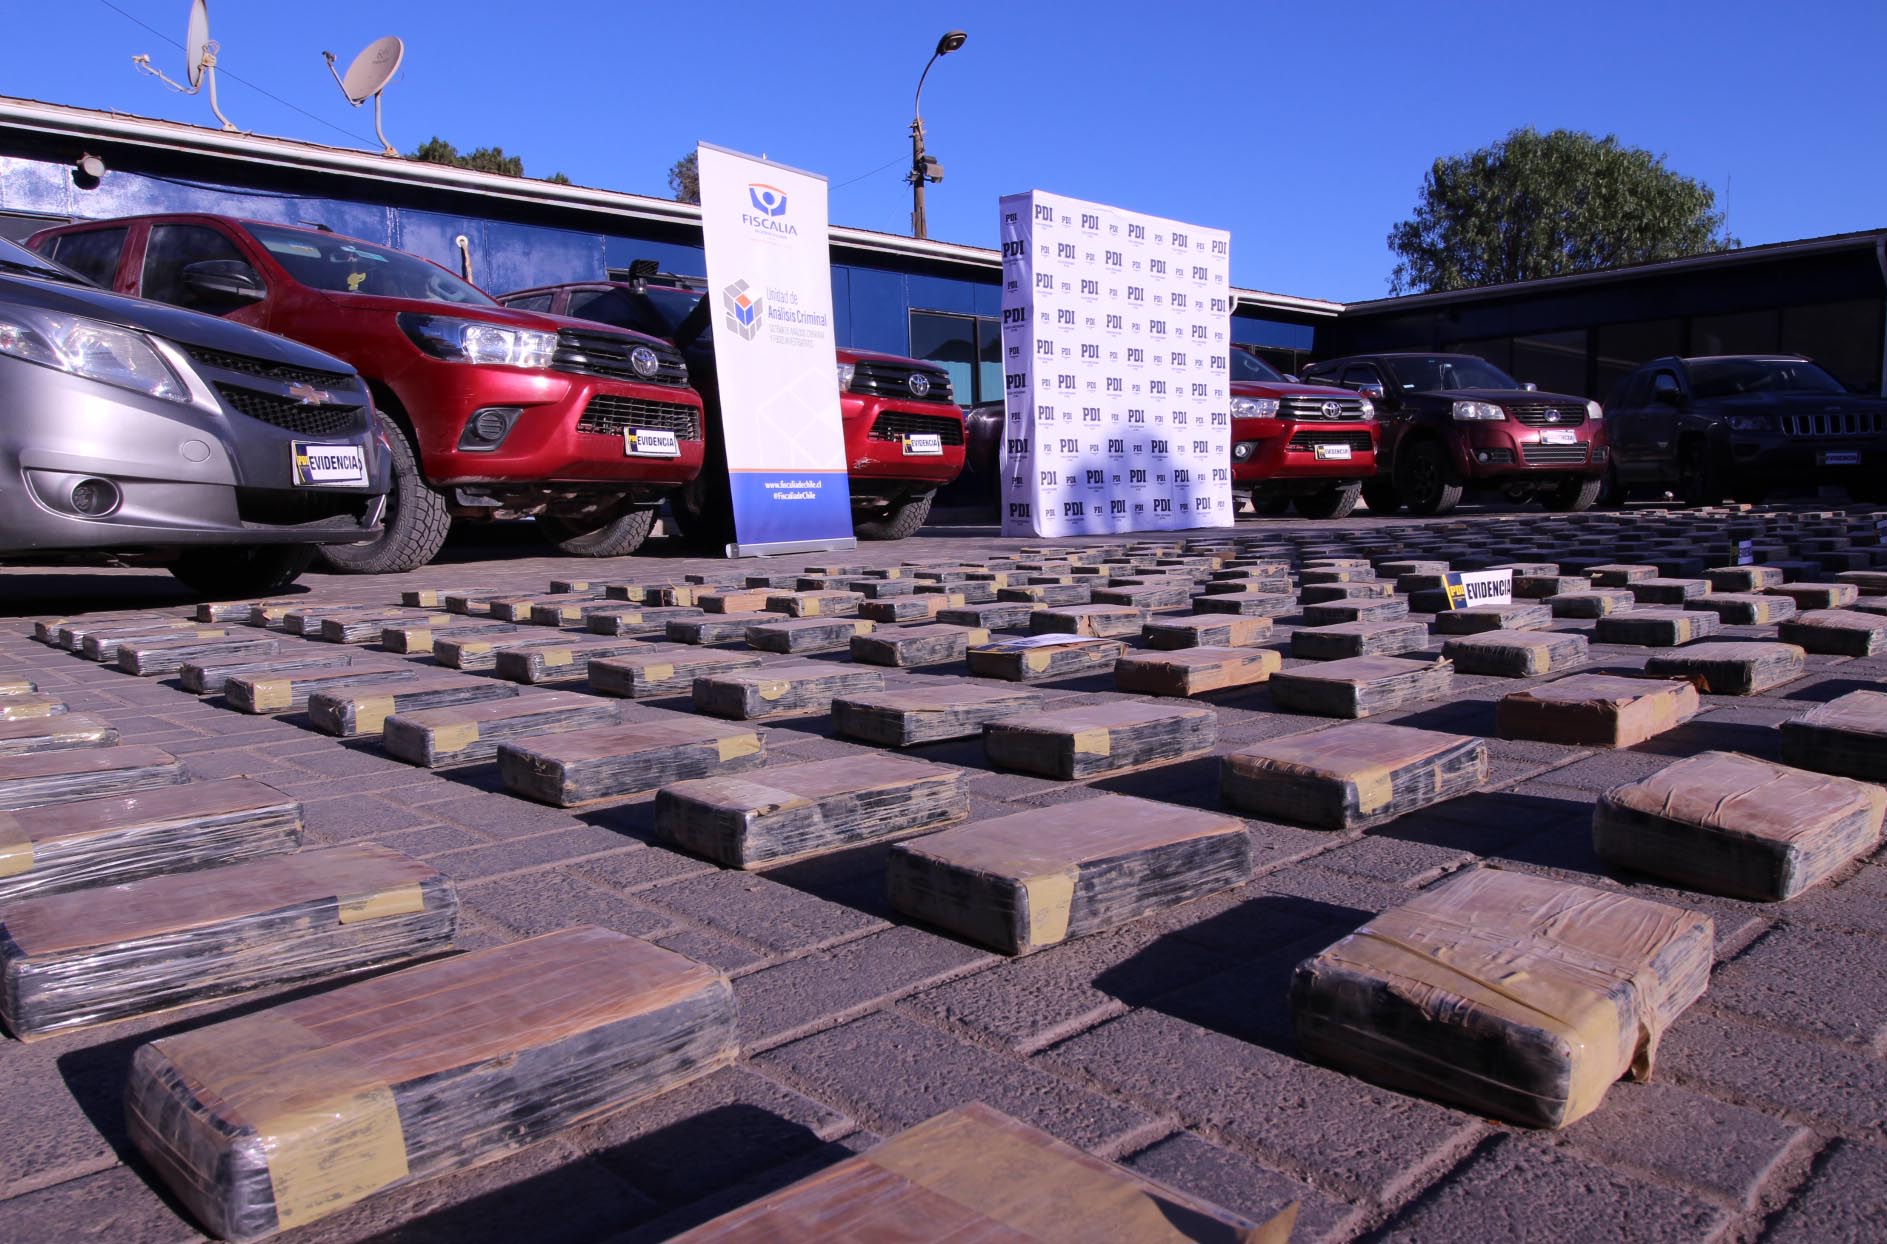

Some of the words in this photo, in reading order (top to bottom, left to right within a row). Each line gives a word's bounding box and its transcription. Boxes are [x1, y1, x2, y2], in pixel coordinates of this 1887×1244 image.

[1035, 204, 1053, 222] PDI
[1082, 214, 1098, 230] PDI
[1128, 224, 1144, 239] PDI
[1172, 232, 1187, 248] PDI
[1212, 240, 1226, 254] PDI
[1003, 240, 1024, 258] PDI
[1058, 243, 1075, 259] PDI
[1106, 251, 1122, 266] PDI
[1150, 259, 1166, 274] PDI
[1193, 266, 1207, 280] PDI
[1036, 273, 1053, 289] PDI
[1081, 280, 1098, 295] PDI
[1128, 286, 1144, 301] PDI
[1172, 293, 1186, 307] PDI
[1211, 298, 1225, 312] PDI
[797, 310, 827, 326] Criminal
[1003, 308, 1025, 324] PDI
[1058, 309, 1074, 324] PDI
[1107, 314, 1122, 329] PDI
[1150, 320, 1166, 334] PDI
[1192, 325, 1206, 338] PDI
[1037, 340, 1053, 355] PDI
[1081, 344, 1099, 358] PDI
[1128, 348, 1143, 362] PDI
[1172, 352, 1186, 366] PDI
[1211, 356, 1225, 369] PDI
[1006, 374, 1026, 389] PDI
[1058, 374, 1076, 389] PDI
[1106, 378, 1122, 391] PDI
[1150, 380, 1166, 394] PDI
[1192, 383, 1207, 396] PDI
[1038, 406, 1054, 420] PDI
[1082, 408, 1100, 421] PDI
[1128, 410, 1144, 423] PDI
[1173, 411, 1186, 424] PDI
[1211, 413, 1226, 425] PDI
[637, 436, 674, 446] EVIDENCIA
[1008, 439, 1028, 453] PDI
[1060, 439, 1078, 452] PDI
[1108, 439, 1125, 453] PDI
[1151, 440, 1168, 453] PDI
[1193, 441, 1208, 453] PDI
[309, 456, 358, 470] EVIDENCIA
[1041, 471, 1056, 485] PDI
[1086, 470, 1106, 484] PDI
[1129, 470, 1148, 483] PDI
[1174, 470, 1189, 482] PDI
[1212, 469, 1226, 480] PDI
[1010, 503, 1030, 517] PDI
[1064, 502, 1083, 516] PDI
[1111, 500, 1125, 513] PDI
[1154, 499, 1171, 512] PDI
[1196, 497, 1210, 510] PDI
[1466, 579, 1510, 600] EVIDENCIA
